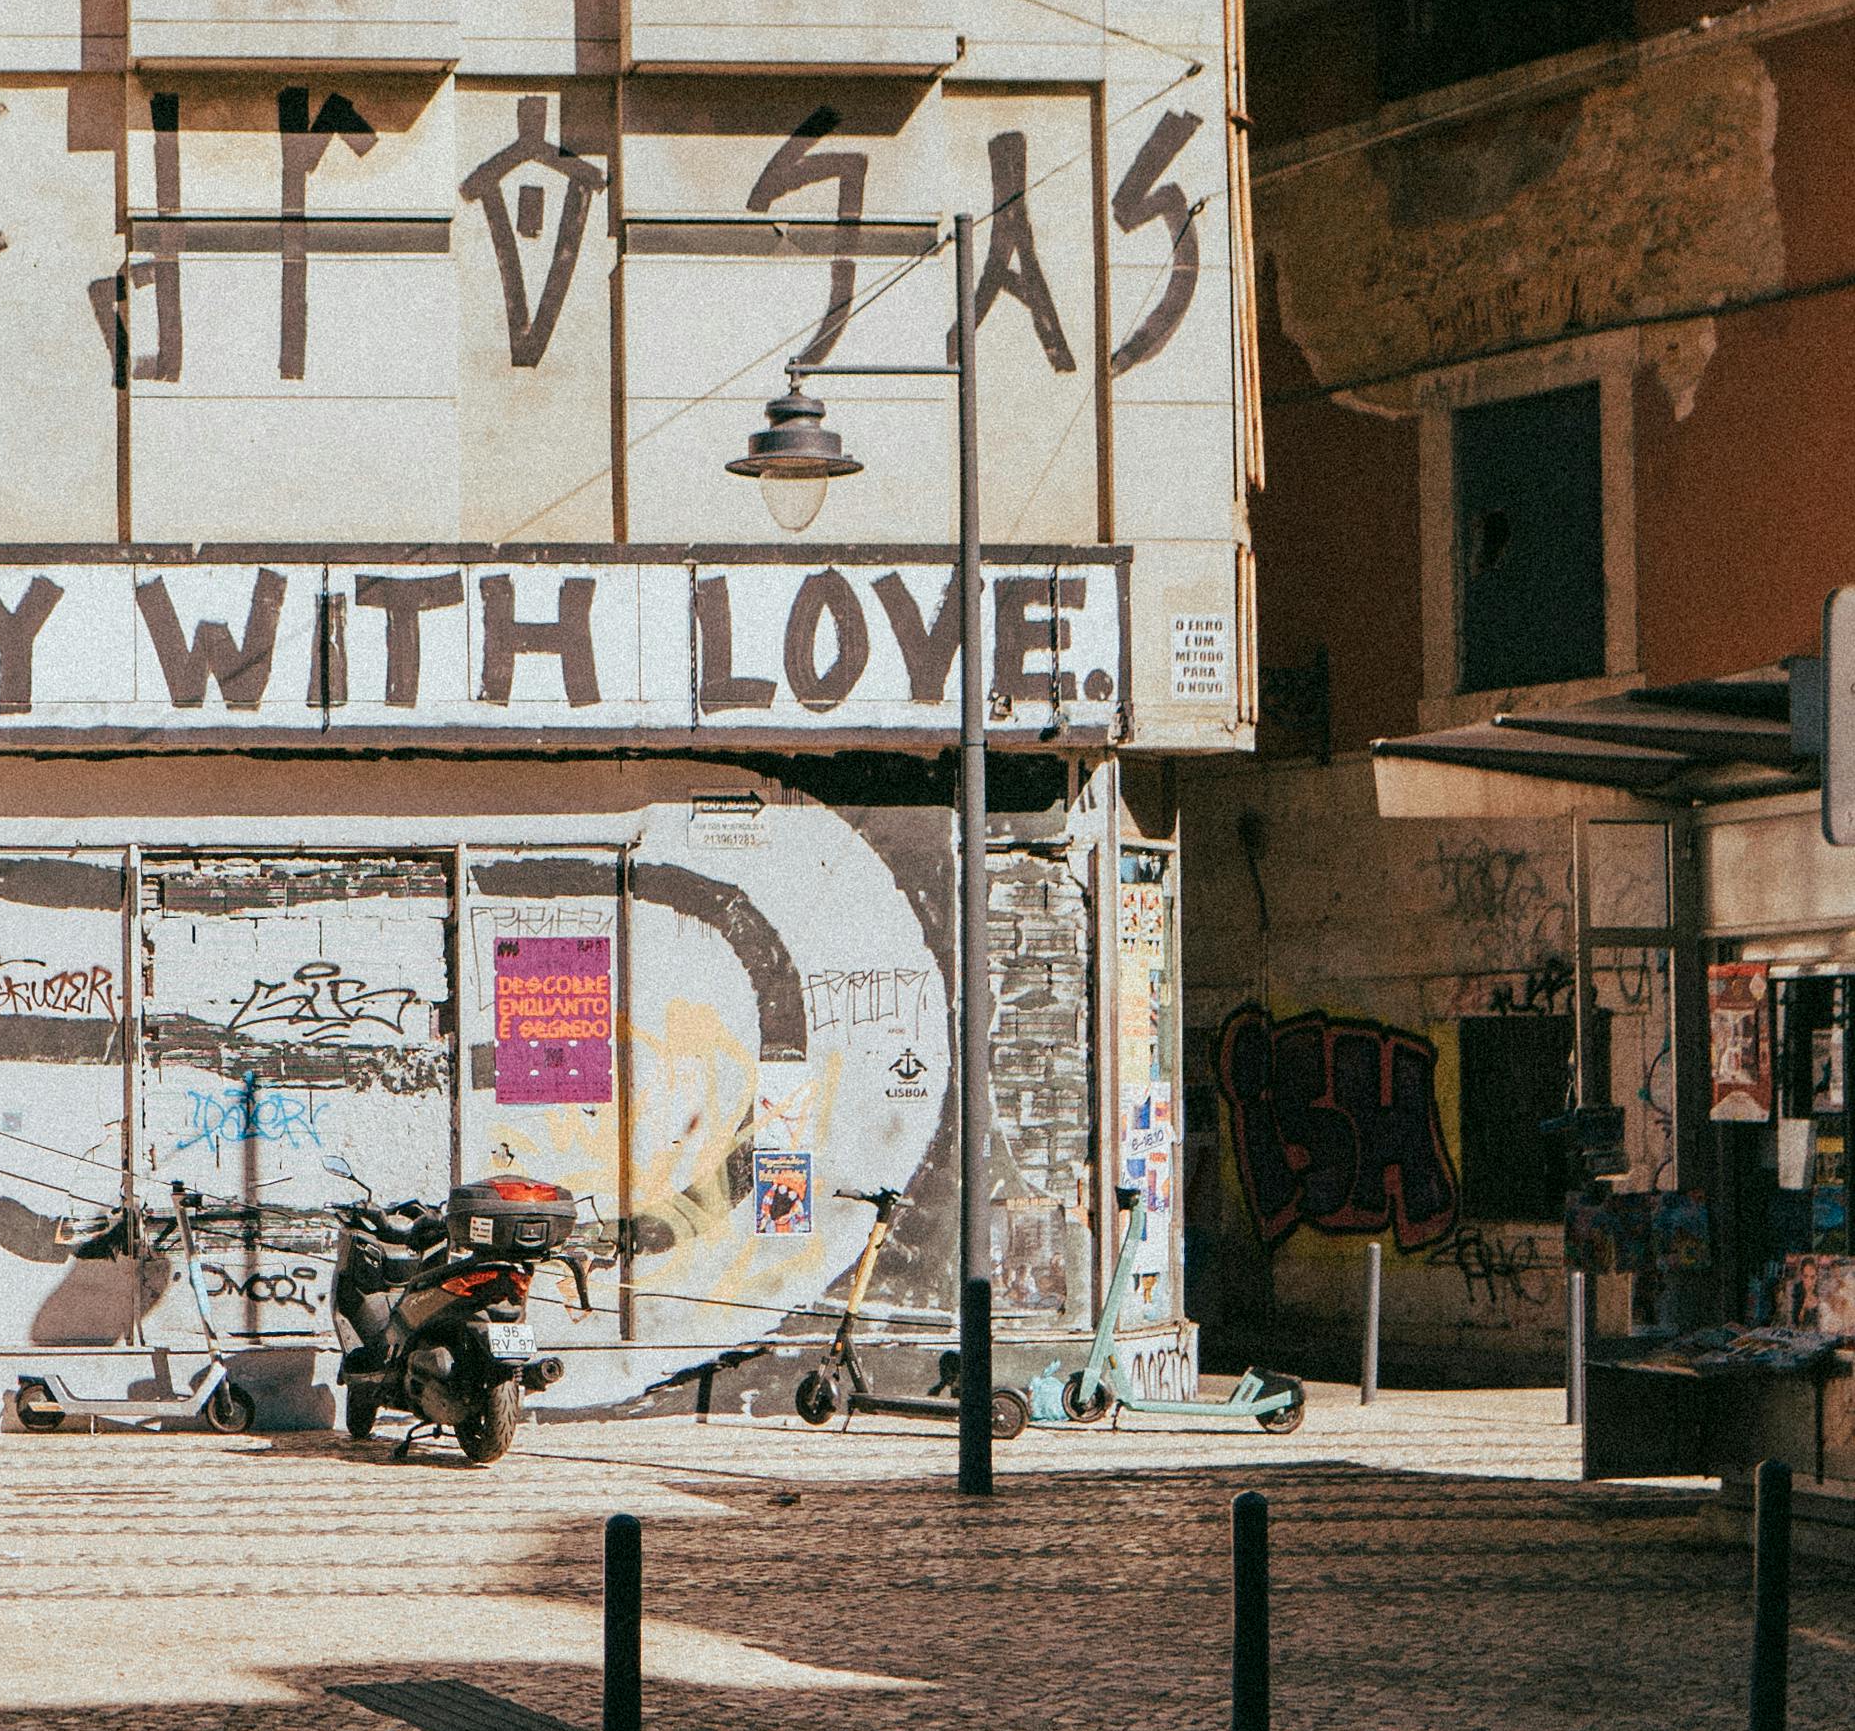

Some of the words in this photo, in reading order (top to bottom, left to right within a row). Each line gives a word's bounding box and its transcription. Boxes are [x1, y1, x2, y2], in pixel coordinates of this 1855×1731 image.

[135, 567, 598, 709] WITH
[694, 566, 1114, 718] LOVE.
[498, 976, 609, 995] DESCOBRE
[498, 997, 609, 1016] ENQUANTO
[518, 1019, 609, 1039] SEGREDO
[887, 1087, 928, 1099] LISBOA
[502, 1326, 519, 1338] 96
[491, 1338, 511, 1351] RV
